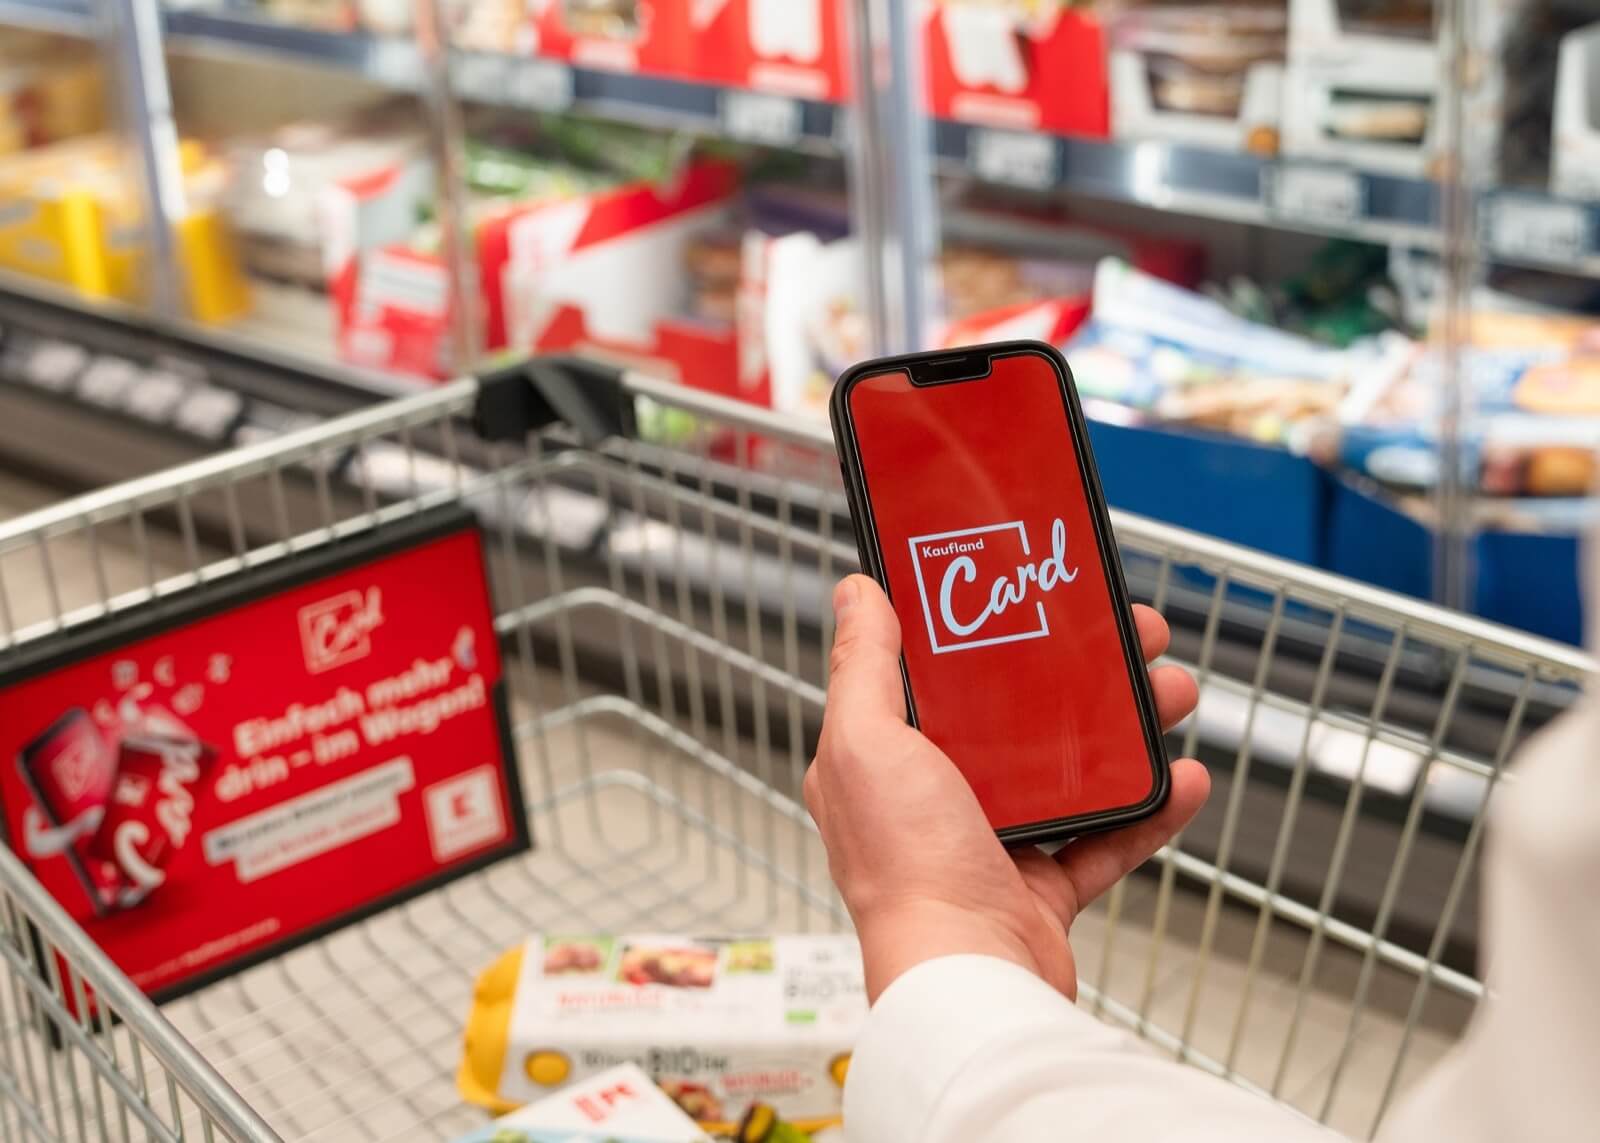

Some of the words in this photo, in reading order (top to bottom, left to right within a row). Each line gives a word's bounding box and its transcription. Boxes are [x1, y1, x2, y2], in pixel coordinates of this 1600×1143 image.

[922, 538, 985, 559] Kaufland
[939, 518, 1078, 636] Card
[233, 687, 364, 758] Einfach
[367, 656, 452, 711] mehr
[215, 755, 289, 802] drin
[311, 729, 360, 767] im
